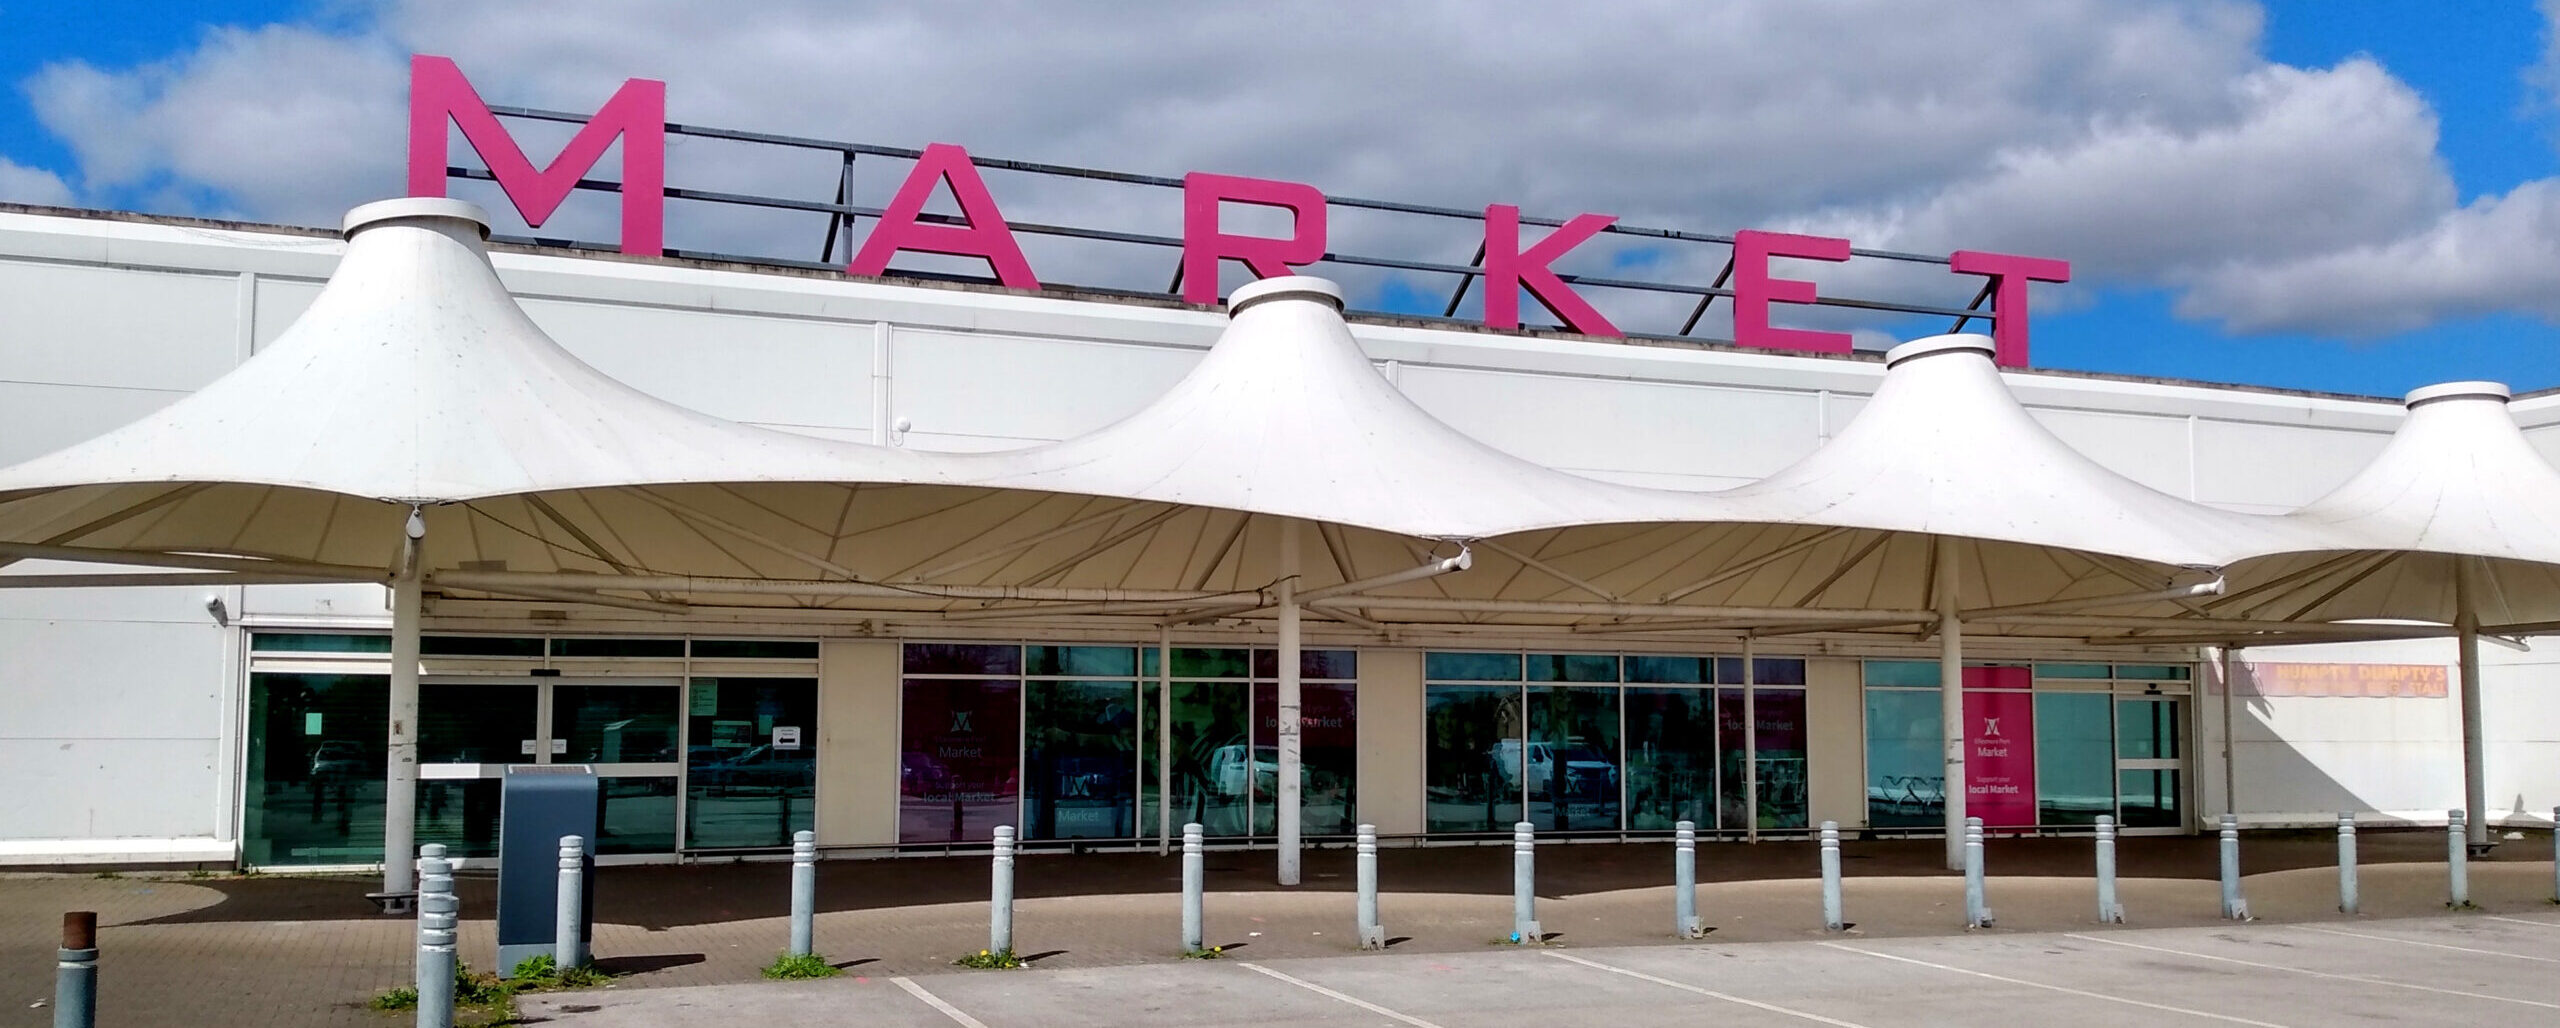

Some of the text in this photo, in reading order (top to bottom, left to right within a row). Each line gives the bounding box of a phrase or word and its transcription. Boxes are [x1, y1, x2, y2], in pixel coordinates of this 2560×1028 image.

[407, 54, 2071, 368] MARKET
[2277, 665, 2445, 681] HUMPTY DUMPTY'S
[939, 746, 983, 759] Market
[1977, 747, 2009, 757] Market
[1968, 785, 2019, 794] local Market
[922, 792, 952, 803] local
[1057, 809, 1099, 822] Market
